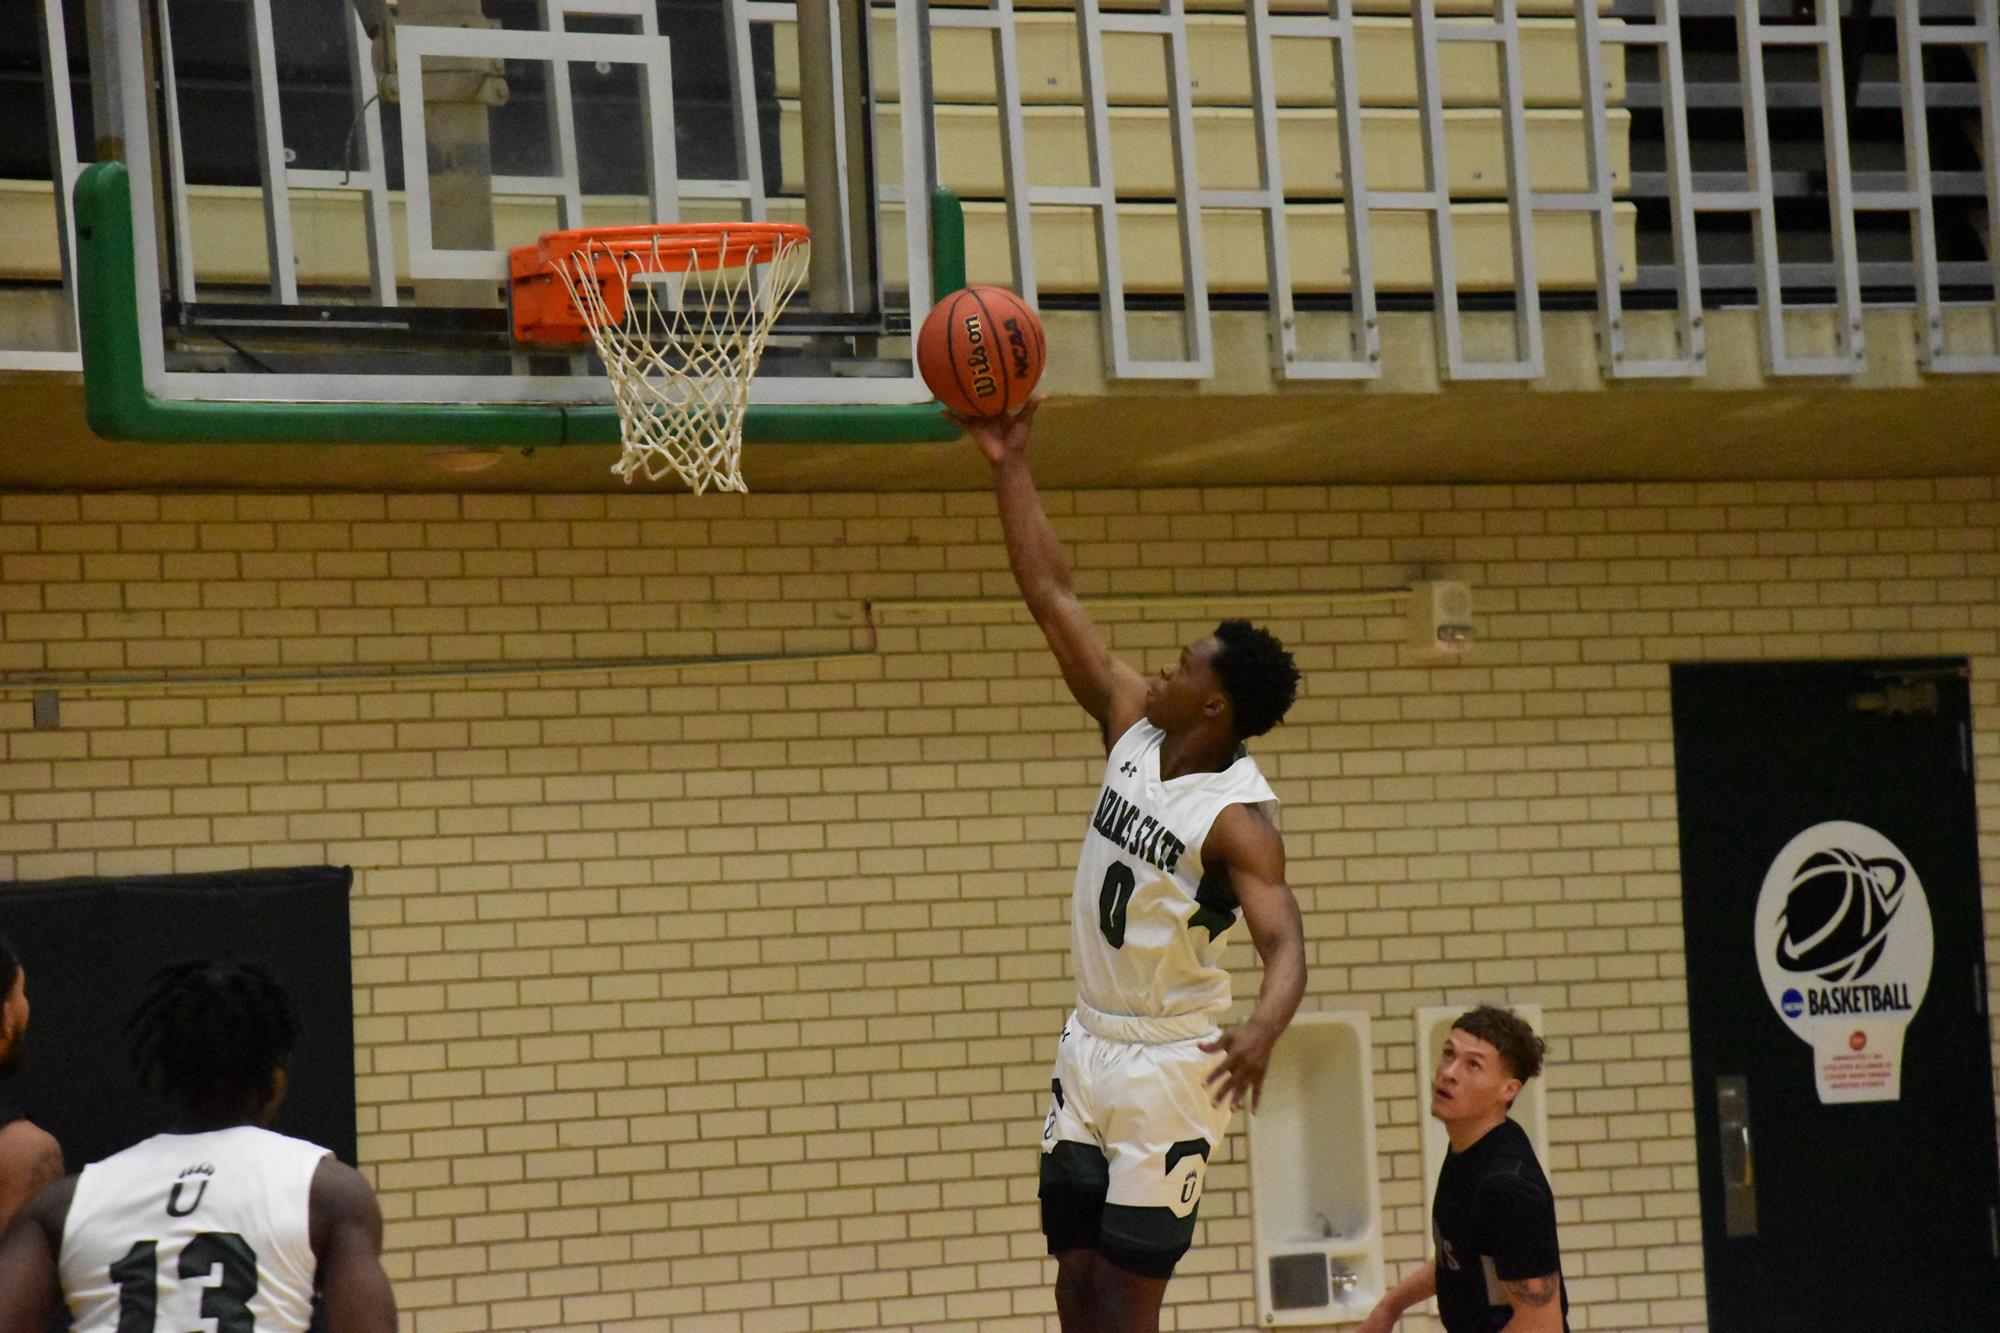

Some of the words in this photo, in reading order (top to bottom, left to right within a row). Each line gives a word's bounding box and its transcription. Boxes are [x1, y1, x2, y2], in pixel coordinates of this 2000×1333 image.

[964, 314, 997, 399] Wilson
[1003, 317, 1029, 379] NCAA
[1093, 786, 1140, 850] ADAMS
[1129, 815, 1186, 875] STATE
[1099, 861, 1136, 950] 0
[1808, 983, 1912, 1016] BASKETBALL
[110, 1231, 258, 1333] 13
